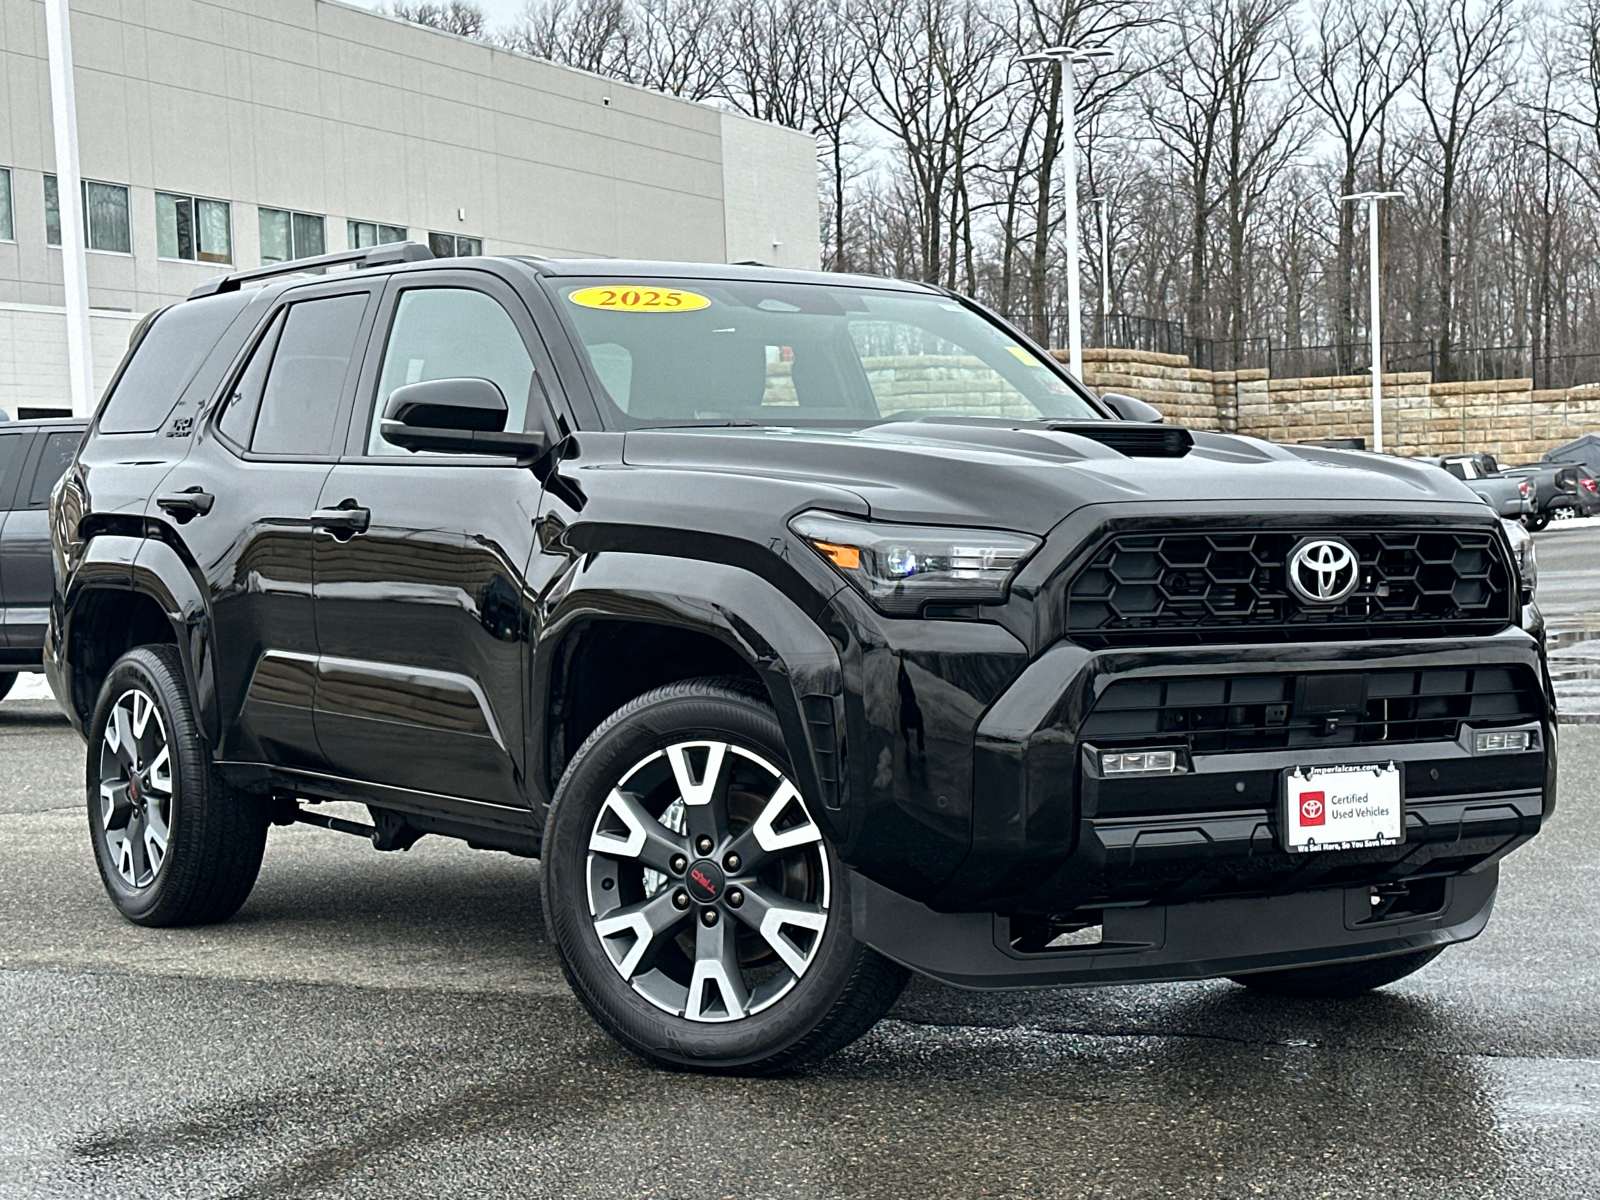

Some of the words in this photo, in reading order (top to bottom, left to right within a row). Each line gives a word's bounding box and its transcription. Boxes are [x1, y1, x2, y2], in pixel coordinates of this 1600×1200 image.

[599, 291, 682, 307] 2025
[1331, 792, 1368, 805] Certified
[1331, 809, 1354, 820] Used
[1355, 806, 1390, 818] Vehicles
[1297, 845, 1308, 853] We
[1309, 843, 1322, 852] Sell
[1341, 841, 1351, 850] So
[1352, 840, 1364, 849] You
[1364, 839, 1380, 848] Save
[1380, 838, 1397, 846] More
